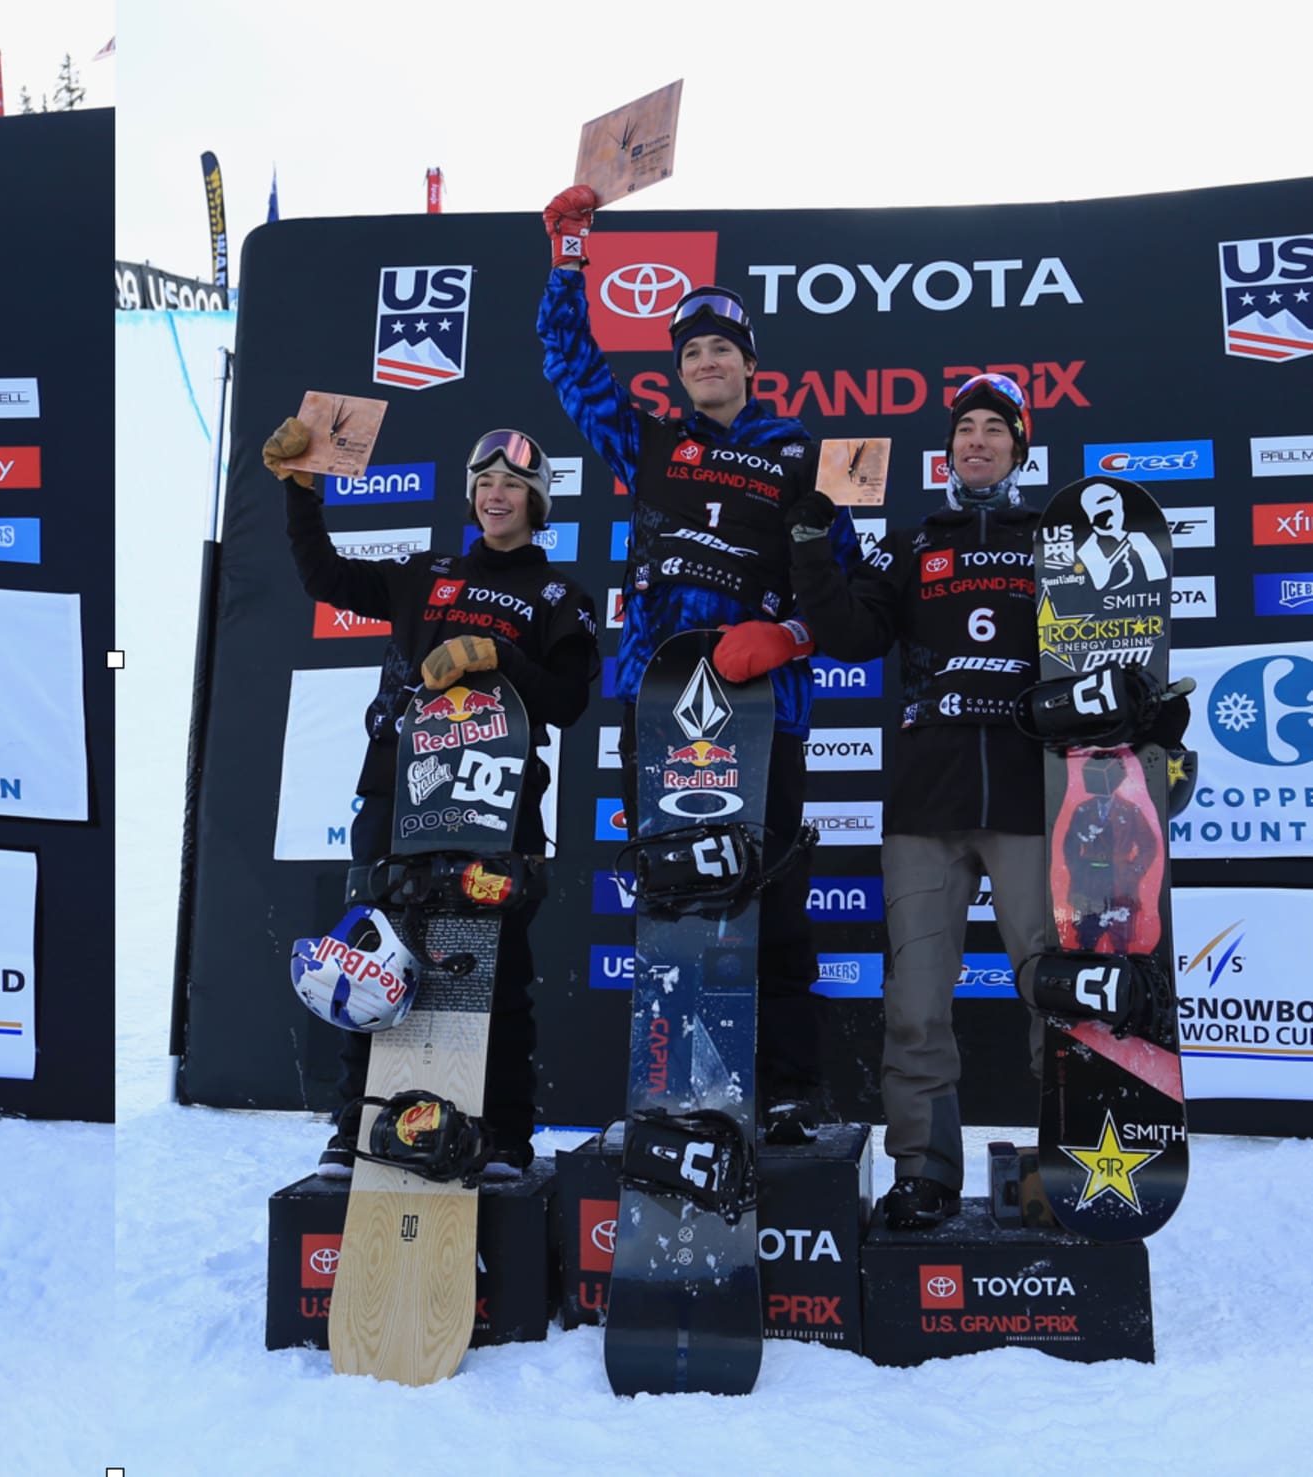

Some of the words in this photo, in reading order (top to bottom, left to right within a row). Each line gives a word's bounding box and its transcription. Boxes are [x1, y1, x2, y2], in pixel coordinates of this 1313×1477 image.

[1222, 238, 1313, 284] US
[383, 269, 468, 311] US
[748, 257, 1084, 315] TOYOTA
[753, 367, 927, 417] RAND
[710, 448, 785, 477] TOYOTA
[1100, 450, 1198, 472] Crest
[1260, 452, 1302, 464] PAUL
[336, 473, 421, 496] USANA
[692, 467, 747, 490] GRAND
[748, 478, 782, 500] PRIX
[705, 502, 722, 528] 1
[660, 528, 760, 557] BOSE
[1042, 524, 1074, 542] US
[687, 560, 743, 584] COPPER
[920, 583, 948, 601] U.S.
[950, 576, 1007, 594] GRAND
[1172, 591, 1208, 604] OTA
[467, 587, 535, 621] TOYOTA
[1103, 592, 1161, 610] SMITH
[446, 608, 493, 627] GRAND
[967, 607, 997, 643] 6
[1057, 640, 1107, 653] ENERGY
[1112, 636, 1154, 649] DRINK
[812, 666, 866, 688] ANA
[935, 656, 1031, 676] BOSE
[412, 729, 459, 755] Red
[461, 713, 509, 745] Bull
[803, 742, 873, 756] TOYOTA
[451, 748, 525, 810] DC
[663, 770, 701, 789] Red
[701, 769, 738, 788] Bull
[1170, 821, 1309, 843] MOUNT
[806, 888, 866, 911] ANA
[315, 935, 365, 975] Bull
[818, 961, 858, 981] AKERS
[355, 962, 406, 1005] Red
[1179, 996, 1313, 1024] SNOWBO
[720, 1019, 734, 1028] 62
[1180, 1023, 1270, 1044] WORLD
[1276, 1026, 1313, 1046] CU
[649, 1017, 670, 1095] CAPITA
[1123, 1123, 1186, 1143] SMITH
[759, 1228, 842, 1263] OTA
[972, 1277, 1076, 1296] TOYOTA
[769, 1294, 843, 1325] PRIX
[921, 1315, 958, 1333] U.S.
[960, 1315, 1031, 1333] GRAND
[1034, 1315, 1079, 1333] PRIX
